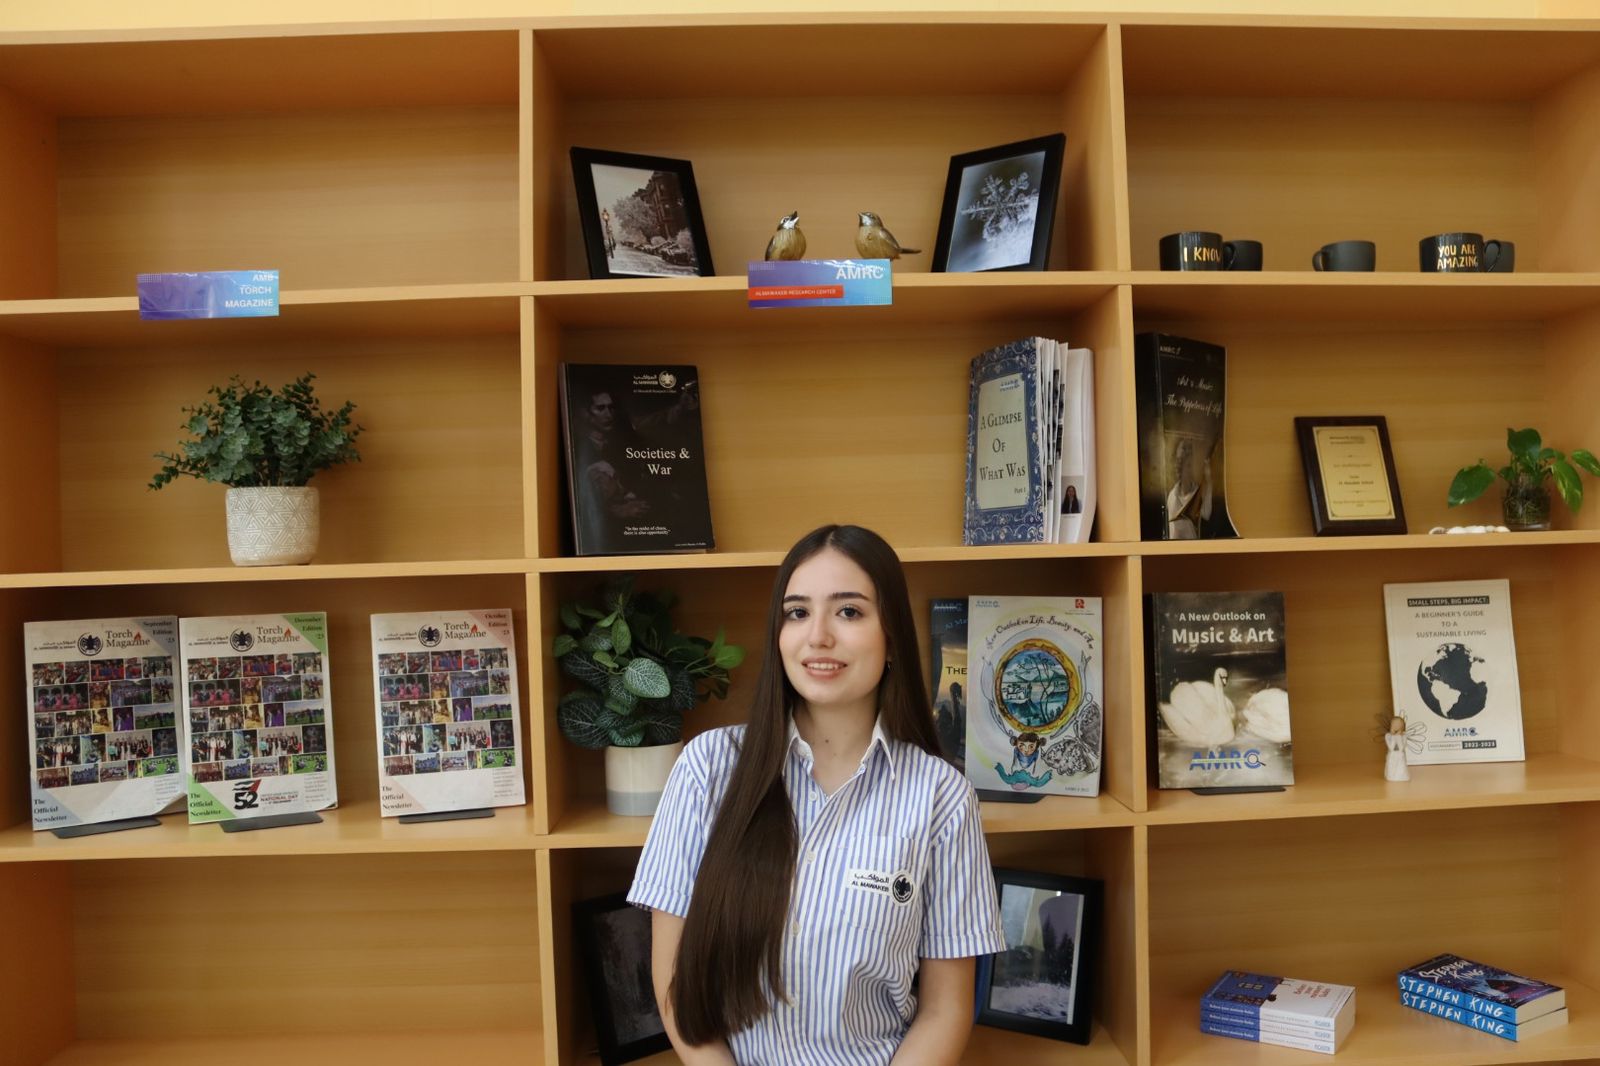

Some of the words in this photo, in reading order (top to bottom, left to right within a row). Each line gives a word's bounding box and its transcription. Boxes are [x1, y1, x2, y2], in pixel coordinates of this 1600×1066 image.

[1184, 247, 1188, 262] I
[1438, 245, 1456, 258] YOU
[1461, 244, 1476, 254] ARE
[252, 273, 274, 281] AMB
[836, 265, 884, 279] AMRC
[240, 285, 272, 294] TORCH
[225, 298, 273, 308] MAGAZINE
[980, 416, 986, 430] A
[625, 447, 676, 459] Societies
[679, 447, 690, 459] &
[647, 464, 672, 475] War
[1179, 613, 1186, 621] A
[1188, 613, 1210, 621] New
[1212, 612, 1252, 621] Outlook
[1422, 611, 1461, 619] BEGINNER'S
[256, 626, 283, 635] Torch
[444, 621, 470, 630] Torch
[105, 629, 133, 639] Torch
[445, 630, 487, 640] Magazine
[1172, 626, 1225, 644] Music
[1229, 628, 1242, 643] &
[1248, 628, 1276, 643] Art
[1416, 630, 1461, 638] SUSTAINABLE
[1463, 629, 1487, 637] LIVING
[106, 638, 151, 649] Magazine
[257, 635, 300, 645] Magazine
[946, 666, 967, 675] THE
[1189, 749, 1262, 770] AMRC
[190, 800, 213, 808] Official
[234, 791, 259, 810] 52
[34, 806, 59, 815] Official
[383, 802, 412, 810] Newsletter
[190, 808, 221, 817] Newsletter
[34, 814, 67, 824] Newsletter
[1419, 959, 1473, 983] STEPHEN
[1451, 968, 1485, 981] KING
[1399, 975, 1460, 1005] STEPHEN
[1469, 997, 1504, 1018] KING
[1401, 991, 1462, 1022] STEPHEN
[1471, 1013, 1505, 1035] KING
